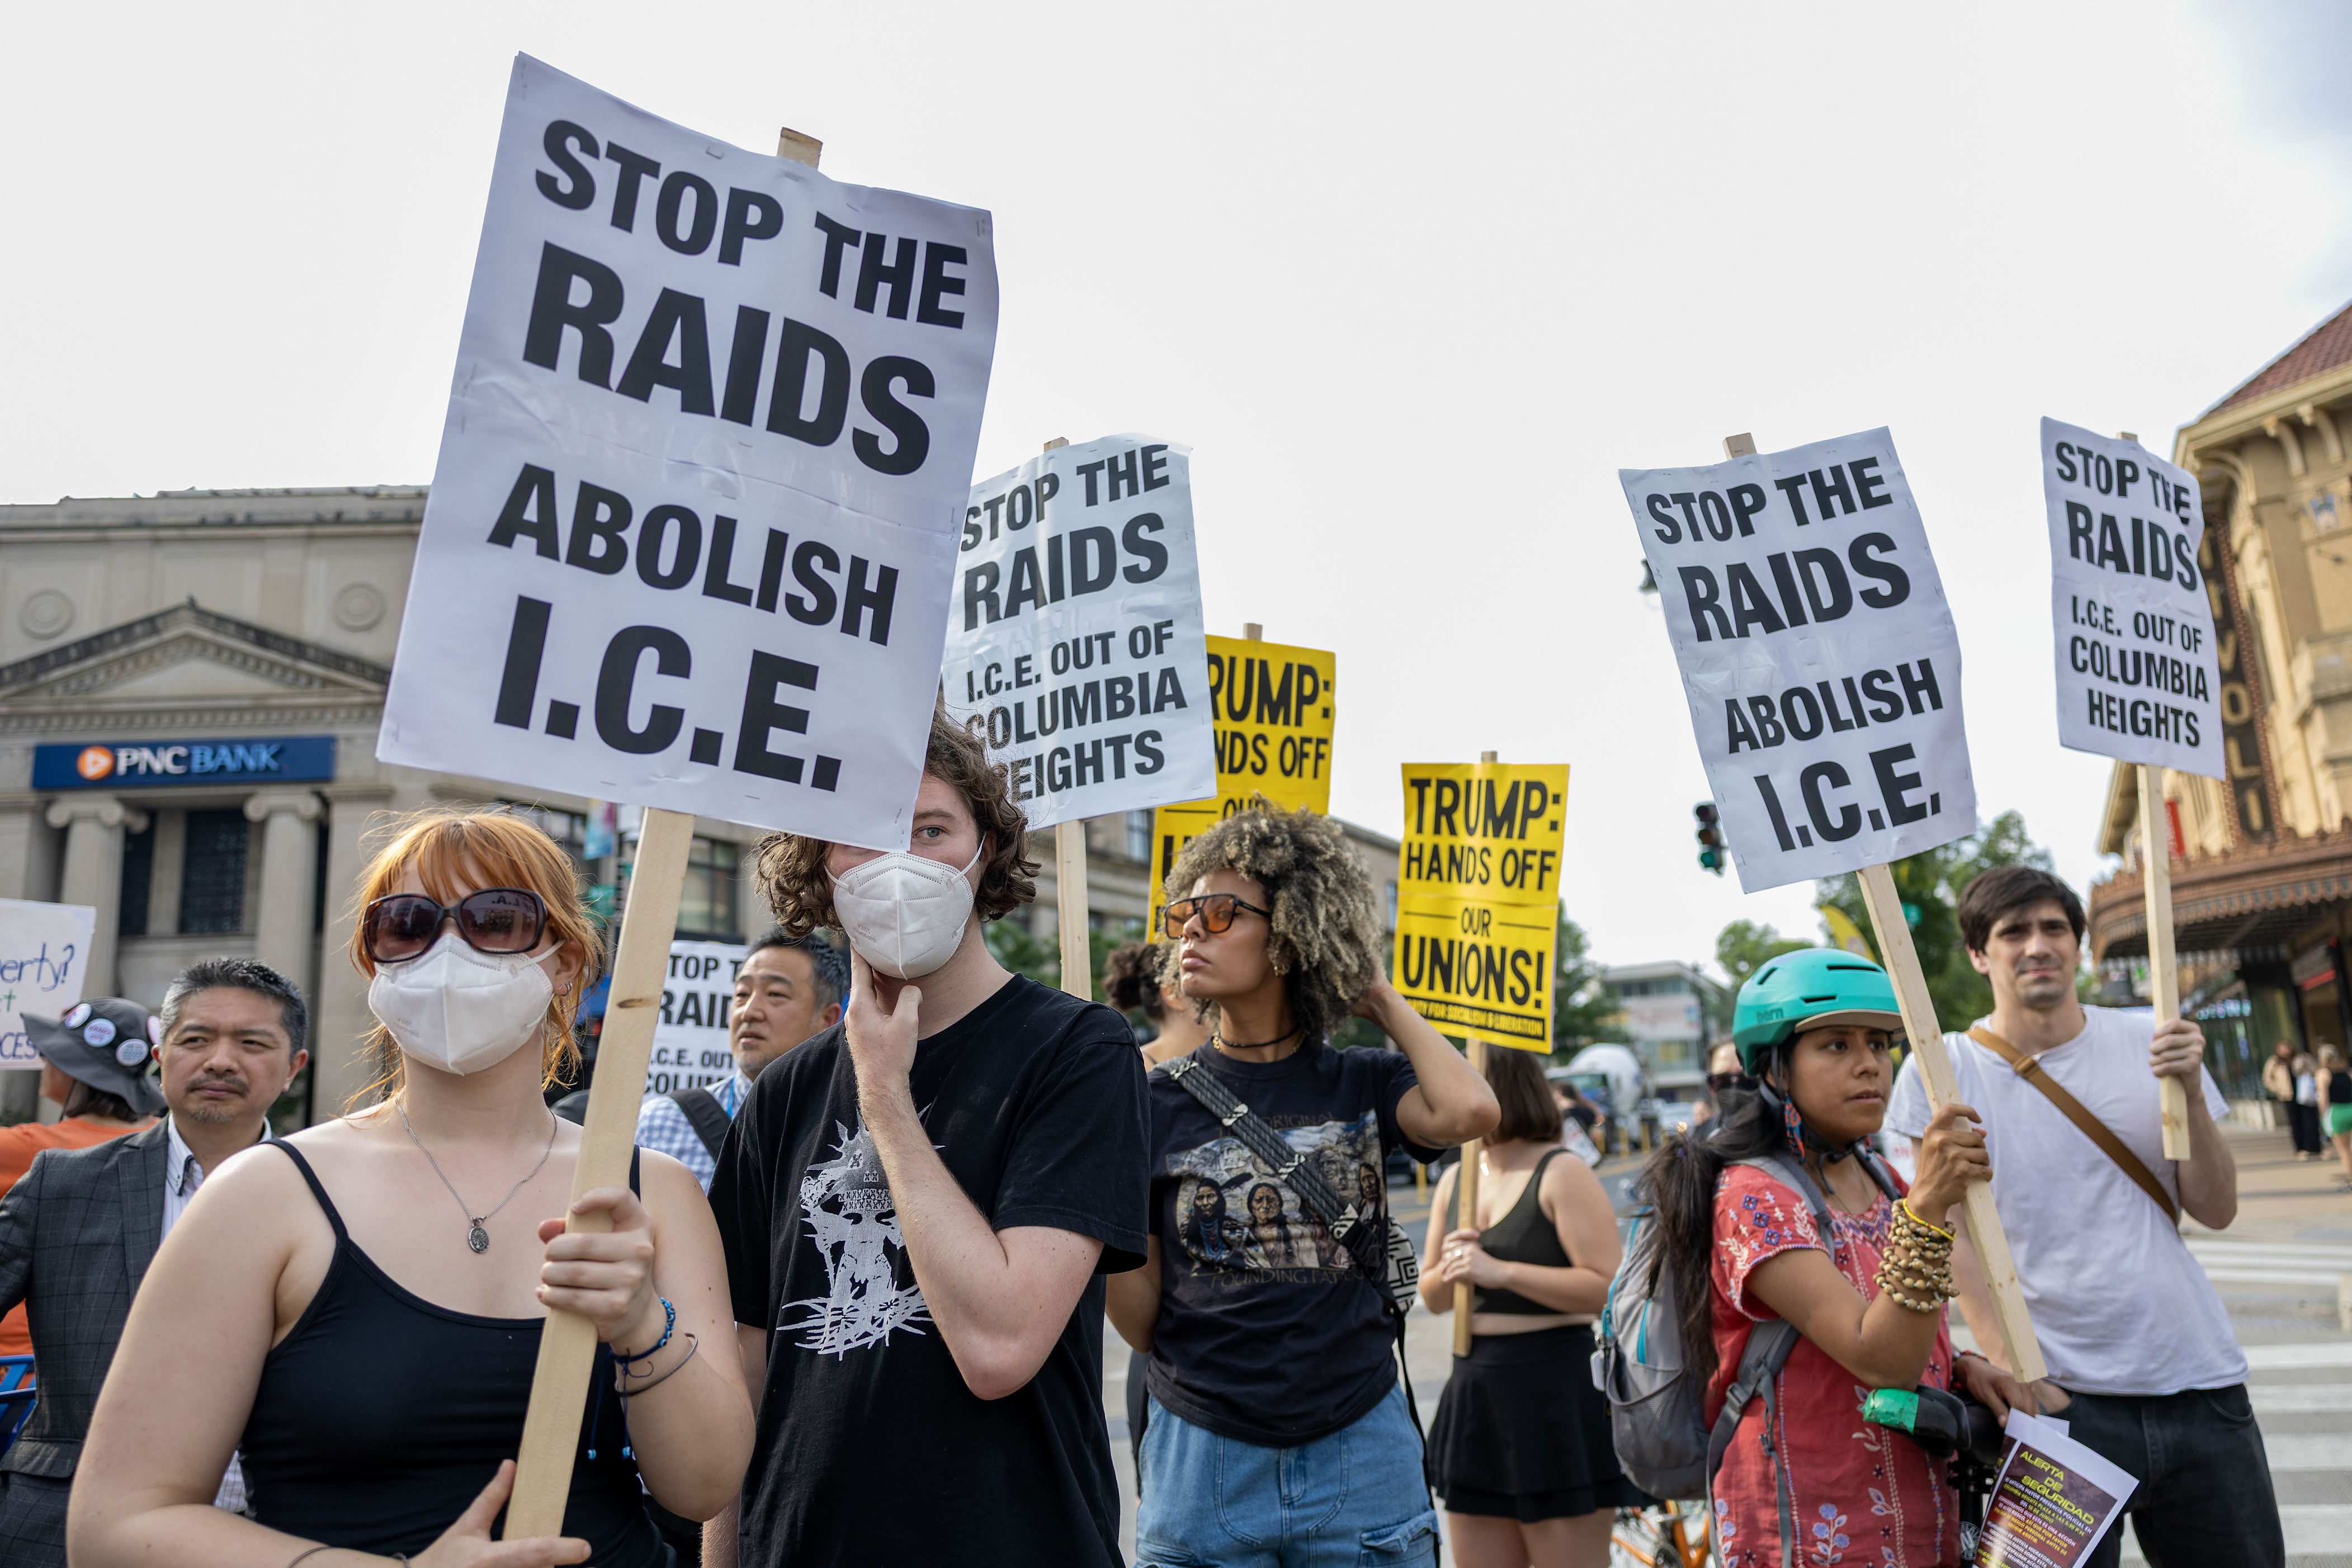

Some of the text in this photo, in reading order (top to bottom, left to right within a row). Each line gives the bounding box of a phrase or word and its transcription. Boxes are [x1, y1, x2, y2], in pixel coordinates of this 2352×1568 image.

[535, 120, 968, 329] STOP THE
[523, 240, 936, 476] RAIDS
[961, 445, 1170, 551] STOP THE
[2056, 442, 2139, 498] STOP
[1646, 456, 1893, 545] STOP THE
[487, 462, 899, 646] ABOLISH
[964, 512, 1169, 632] RAIDS
[2066, 500, 2197, 592] RAIDS
[1676, 532, 1910, 642] RAIDS
[2072, 596, 2202, 654] I.C.E. OUT OF
[967, 619, 1173, 702] I.C.E. OUT OF
[1207, 653, 1330, 727] RUMP:
[2070, 636, 2209, 703] COLUMBIA
[494, 596, 841, 793] I.C.E.
[1725, 657, 1943, 754] ABOLISH
[2087, 688, 2200, 748] HEIGHTS
[116, 743, 281, 776] PNC BANK
[1010, 730, 1165, 804] EIGHTS
[1215, 729, 1328, 779] NDS OFF
[1410, 778, 1561, 839] TRUMP:
[1754, 743, 1942, 852] I.C.E.
[1405, 842, 1556, 891] HANDS OFF
[1461, 907, 1491, 937] OUR
[0, 942, 74, 991] erty?
[669, 955, 719, 979] TOP
[1402, 934, 1544, 1009] UNIONS!
[2020, 1451, 2065, 1481] ALERTA
[2044, 1477, 2063, 1493] DE
[2019, 1499, 2029, 1508] DEL
[2038, 1512, 2055, 1524] JUNIO
[2020, 1493, 2039, 1506] HEIGHTS
[2037, 1503, 2052, 1515] PLAZA
[2055, 1514, 2066, 1524] LAS
[2021, 1475, 2094, 1526] SEGURIDAD
[2023, 1509, 2033, 1519] QUE
[2047, 1525, 2059, 1535] UNA
[2024, 1488, 2041, 1500] MAYOR
[2039, 1496, 2064, 1515] PRESENCIA
[2062, 1512, 2086, 1529] POLICIAL
[2084, 1526, 2093, 1534] EN
[2027, 1546, 2054, 1566] MIGRATORIA
[2032, 1522, 2043, 1532] QUE
[2041, 1528, 2053, 1538] POR
[2052, 1535, 2068, 1549] FAVOR
[2046, 1539, 2061, 1552] ANTES
